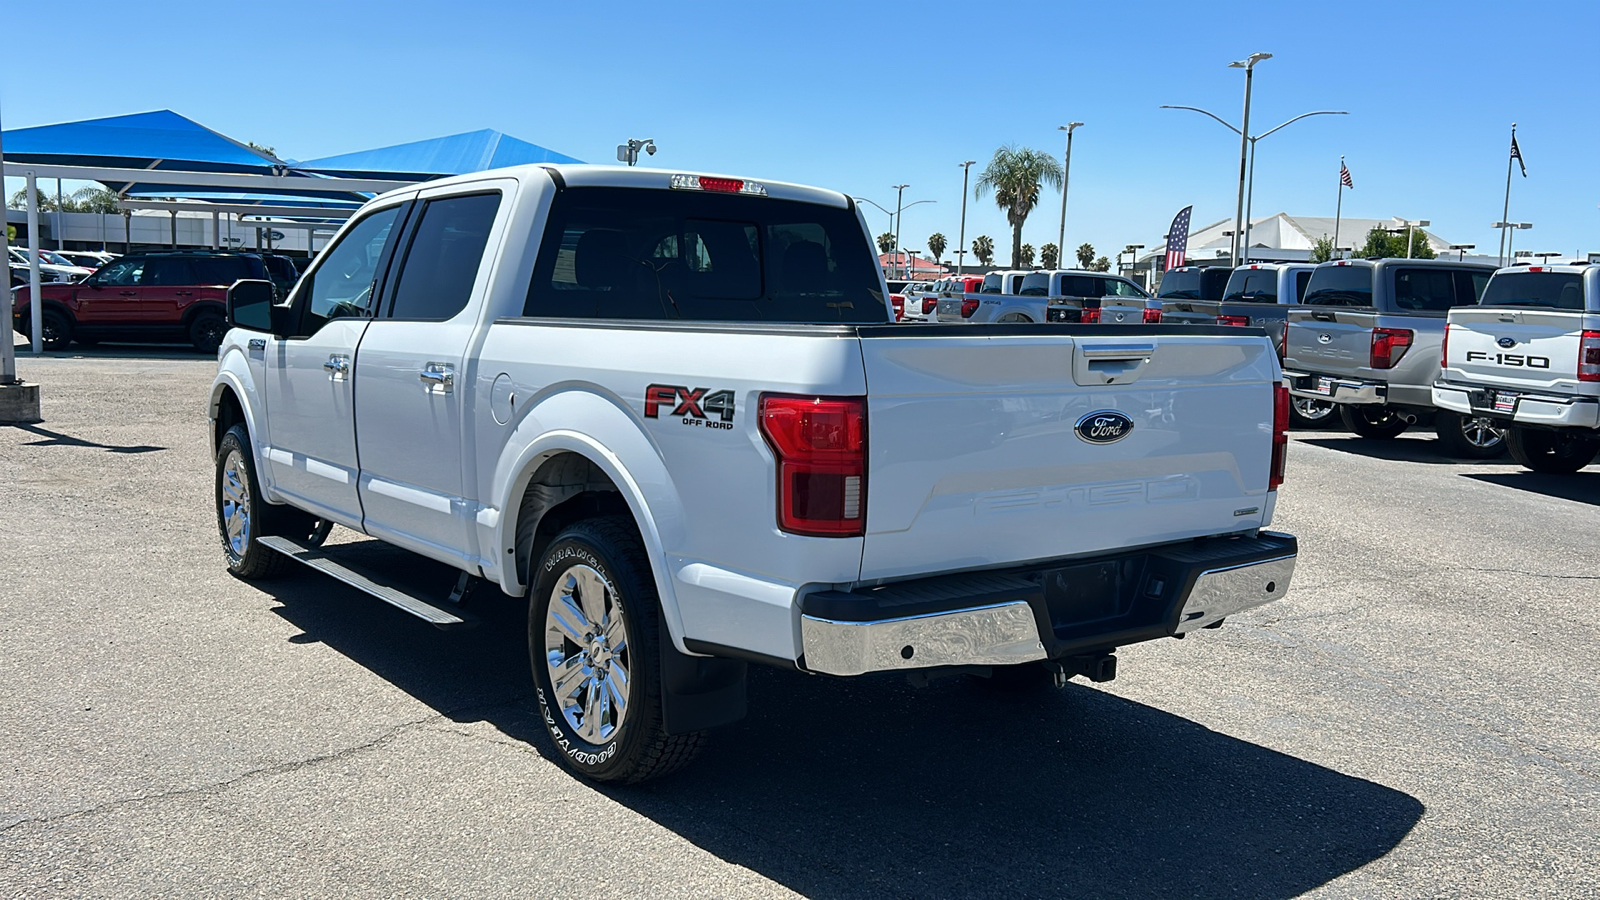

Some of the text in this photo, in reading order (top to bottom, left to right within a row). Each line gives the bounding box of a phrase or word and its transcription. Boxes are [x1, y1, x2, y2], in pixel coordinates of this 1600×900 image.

[1466, 351, 1550, 369] F-150
[644, 383, 736, 423] FX4
[682, 418, 734, 431] OFF ROAD
[1090, 417, 1123, 437] Ford
[544, 546, 625, 614] WRANGLER
[537, 687, 617, 766] GOODYEAR
